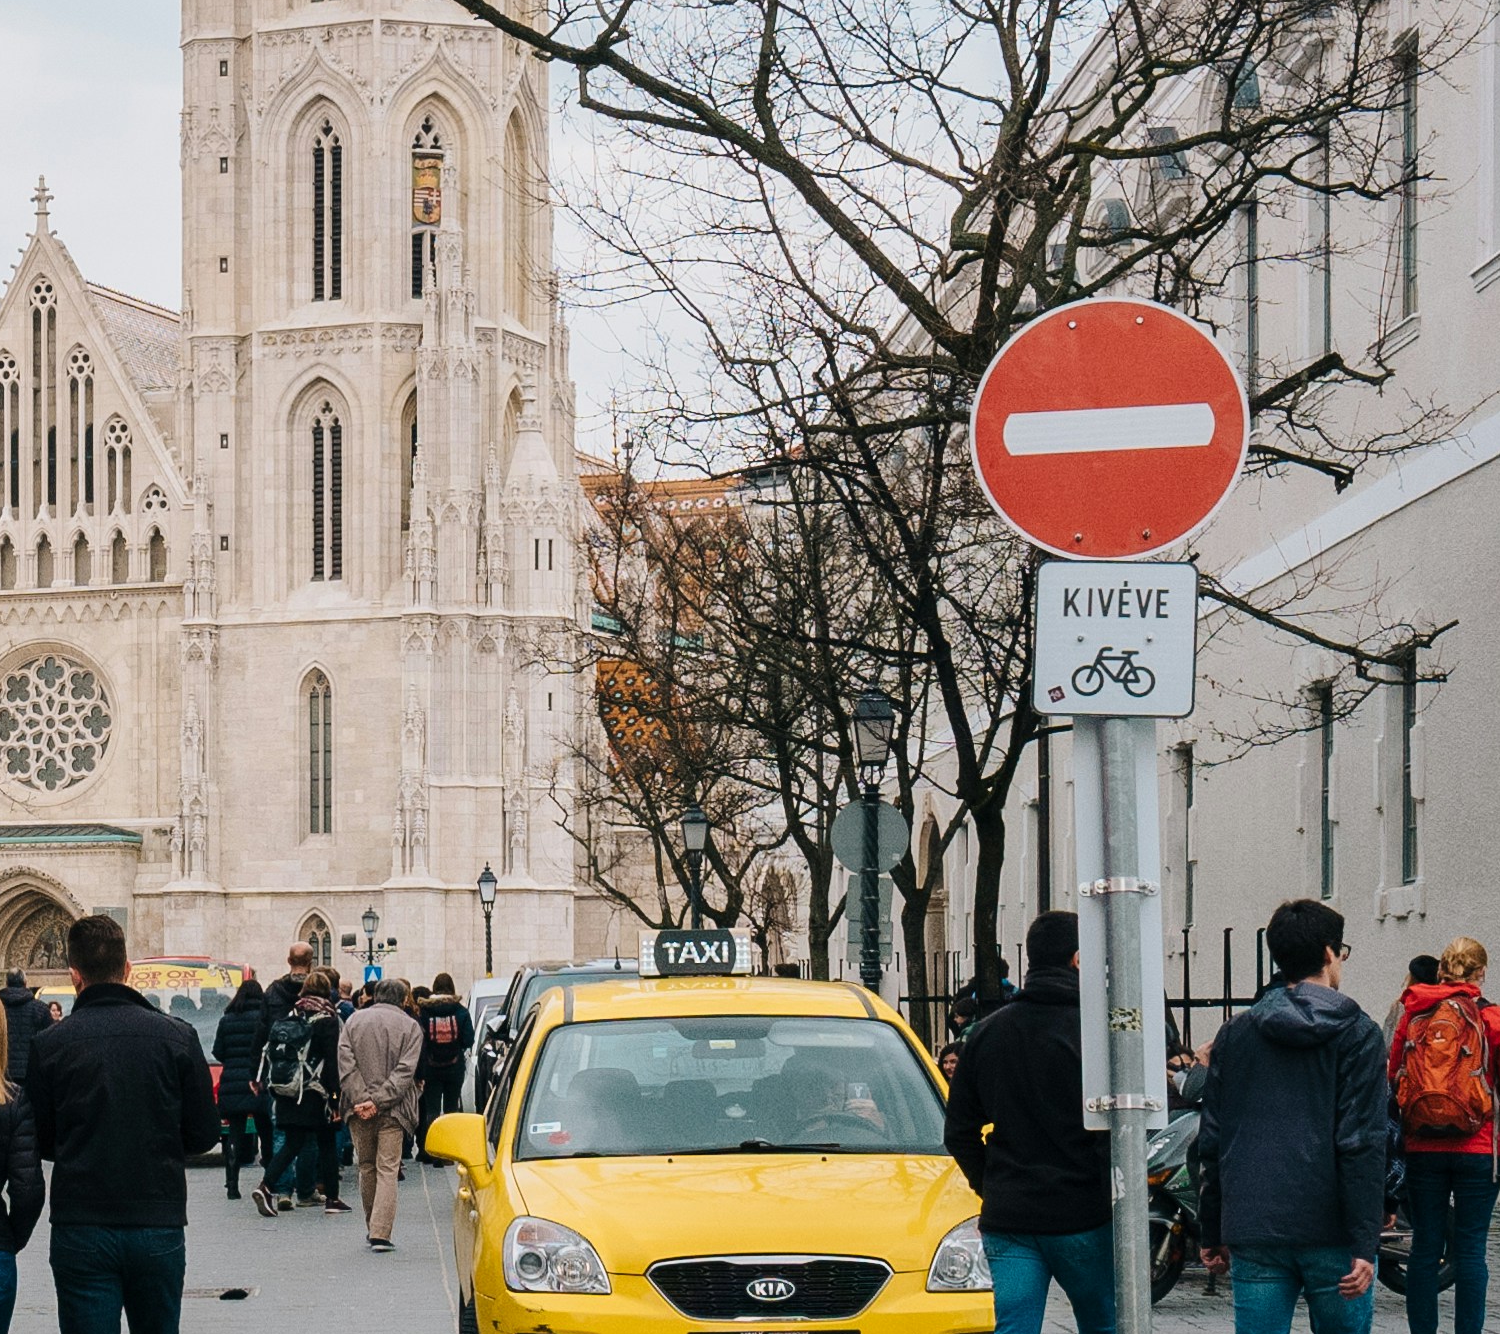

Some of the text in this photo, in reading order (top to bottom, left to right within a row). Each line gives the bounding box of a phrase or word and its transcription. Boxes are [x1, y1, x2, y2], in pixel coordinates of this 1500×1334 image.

[1063, 580, 1170, 619] KIVÉVE
[662, 940, 729, 964] TAXI
[167, 969, 198, 979] ON
[166, 978, 203, 989] OFF
[754, 1282, 788, 1296] KIA
